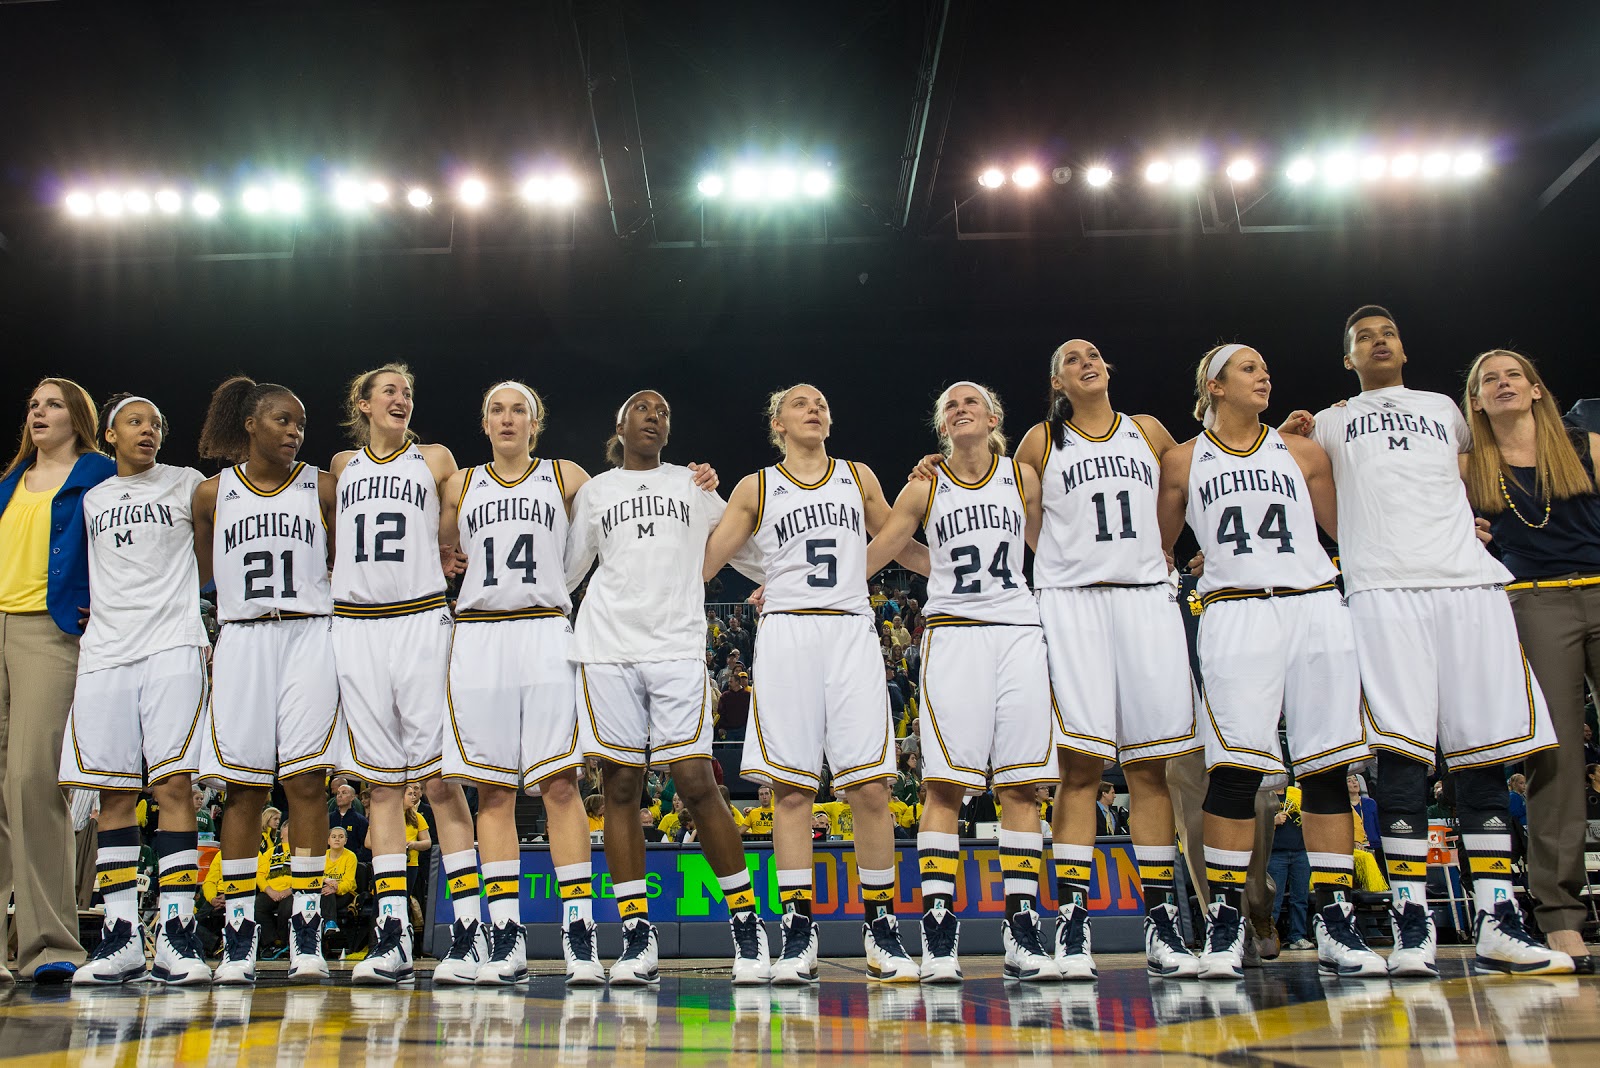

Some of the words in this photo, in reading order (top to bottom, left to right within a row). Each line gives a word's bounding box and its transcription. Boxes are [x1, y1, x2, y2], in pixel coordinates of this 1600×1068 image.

[1345, 411, 1449, 445] MICHIGAN
[1387, 436, 1411, 451] M
[340, 475, 428, 515] MICHIGAN
[1061, 455, 1154, 495] MICHIGAN
[1198, 469, 1297, 512] MICHIGAN
[89, 503, 174, 545] MICHIGAN
[223, 512, 316, 556] MICHIGAN
[354, 512, 407, 563] 12
[466, 497, 556, 539] MICHIGAN
[601, 495, 691, 539] MICHIGAN
[636, 522, 655, 539] M
[774, 502, 861, 550] MICHIGAN
[935, 503, 1022, 549] MICHIGAN
[1091, 490, 1137, 542] 11
[1216, 503, 1295, 556] 44
[114, 530, 134, 549] M
[482, 533, 537, 587] 14
[243, 550, 297, 601] 21
[805, 538, 837, 588] 5
[950, 541, 1018, 594] 24
[524, 871, 663, 899] TIES
